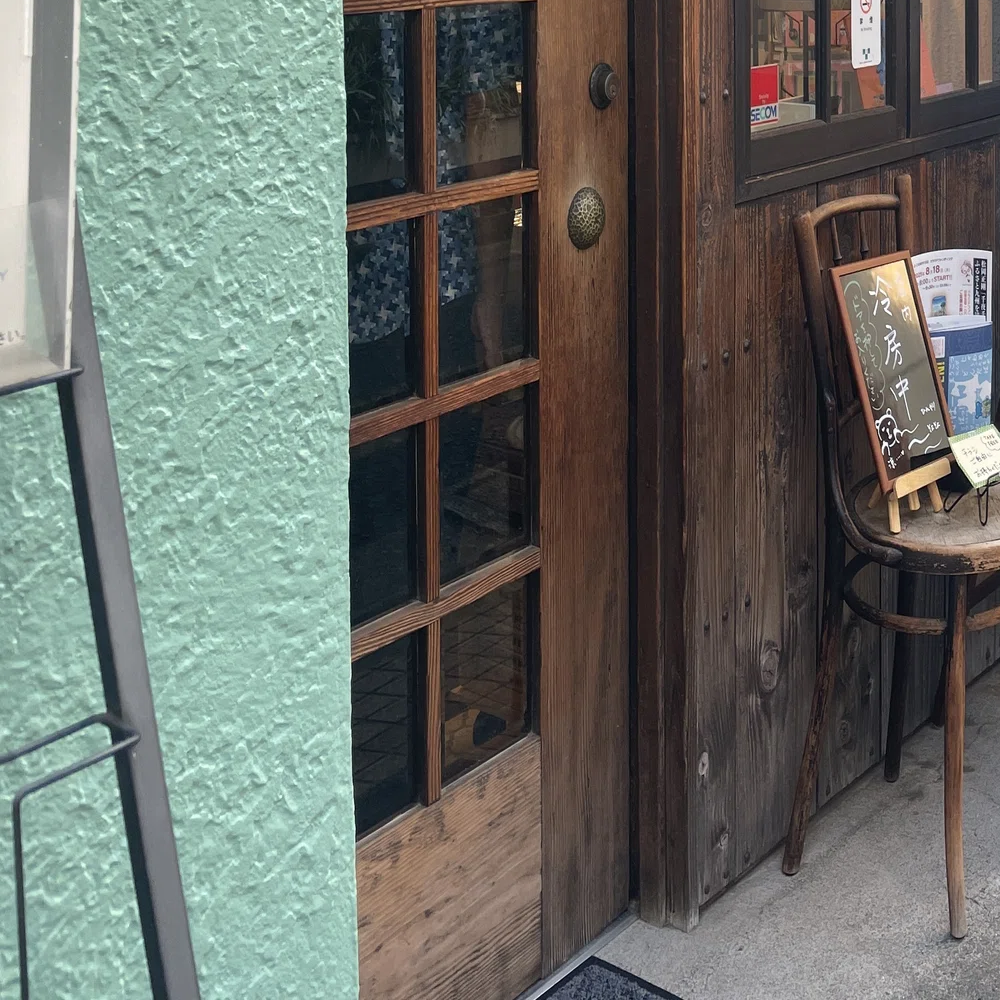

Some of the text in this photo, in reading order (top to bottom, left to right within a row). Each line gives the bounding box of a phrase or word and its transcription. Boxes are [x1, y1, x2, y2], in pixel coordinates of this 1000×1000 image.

[750, 104, 777, 122] SECOM
[868, 275, 911, 421] 冷房中
